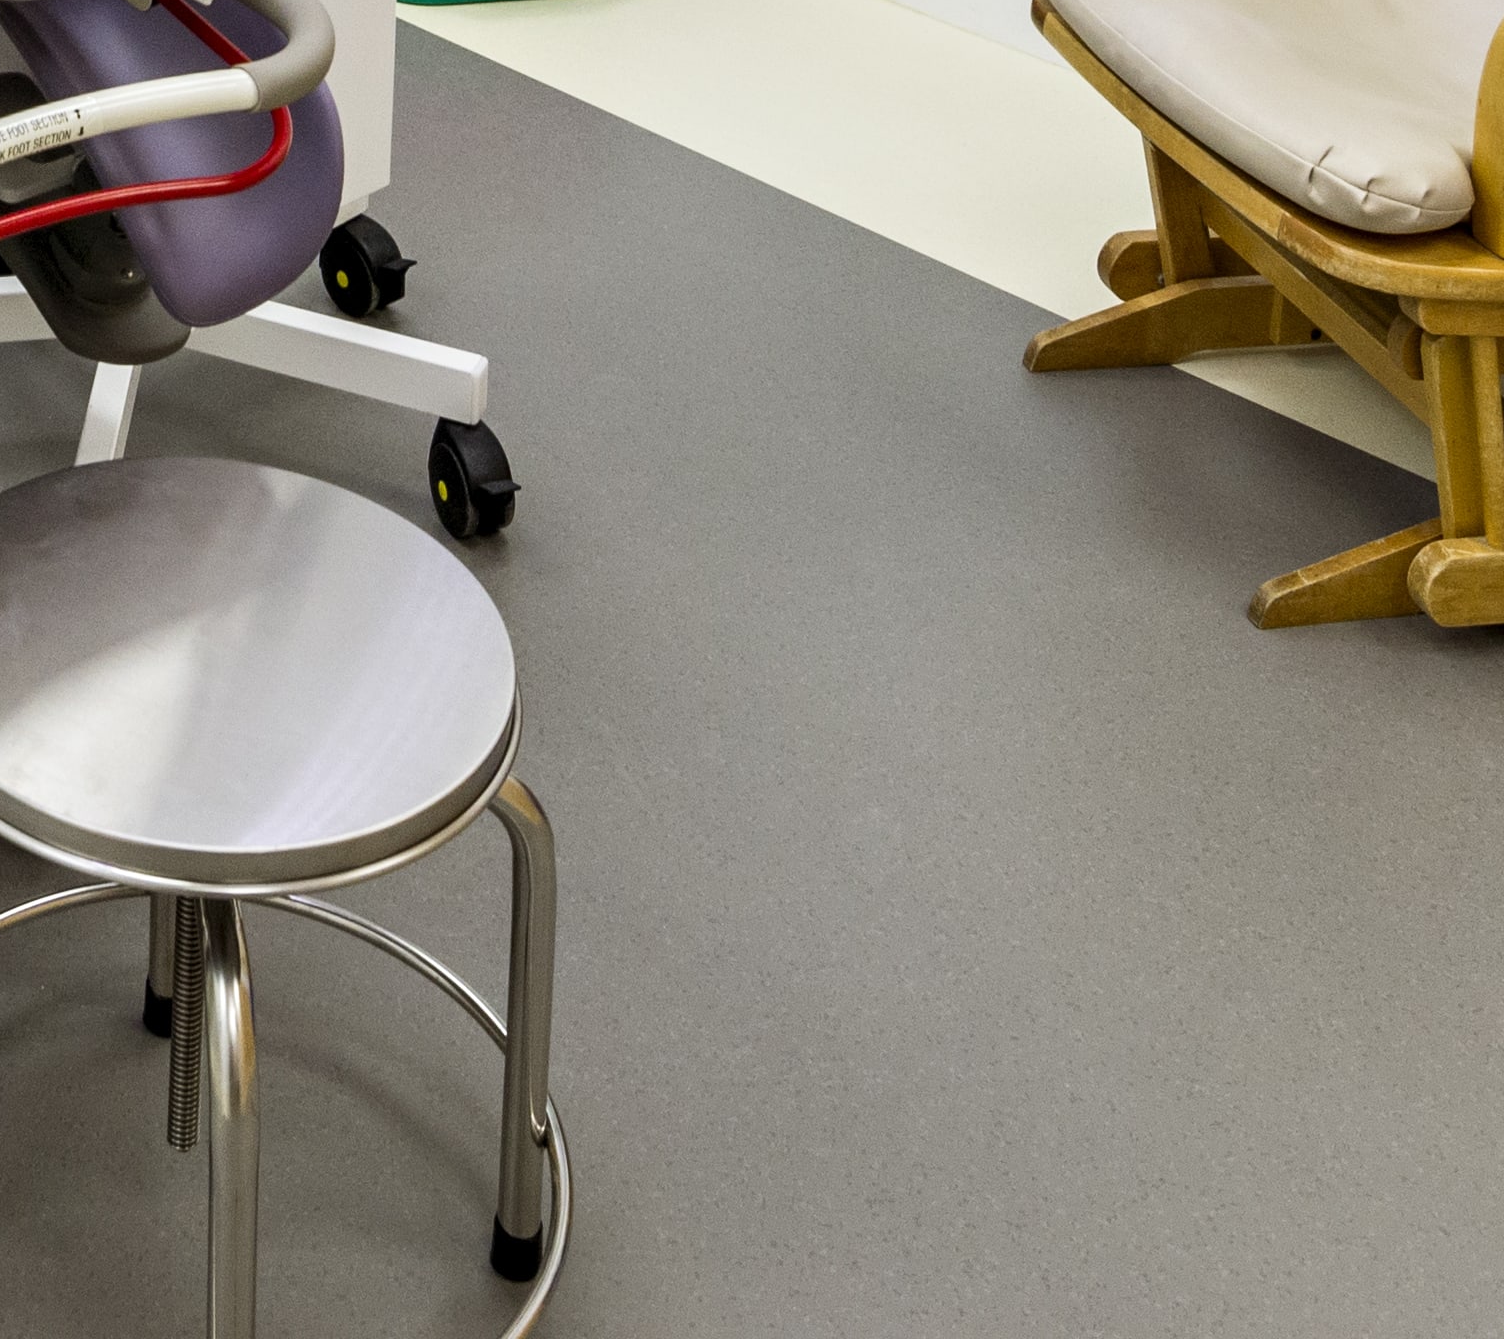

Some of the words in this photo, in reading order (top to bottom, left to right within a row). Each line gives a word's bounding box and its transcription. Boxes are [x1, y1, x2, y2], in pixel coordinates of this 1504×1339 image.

[7, 124, 30, 140] FOOT
[32, 111, 70, 132] SECTION
[7, 140, 31, 158] FOOT
[33, 129, 73, 151] SECTION
